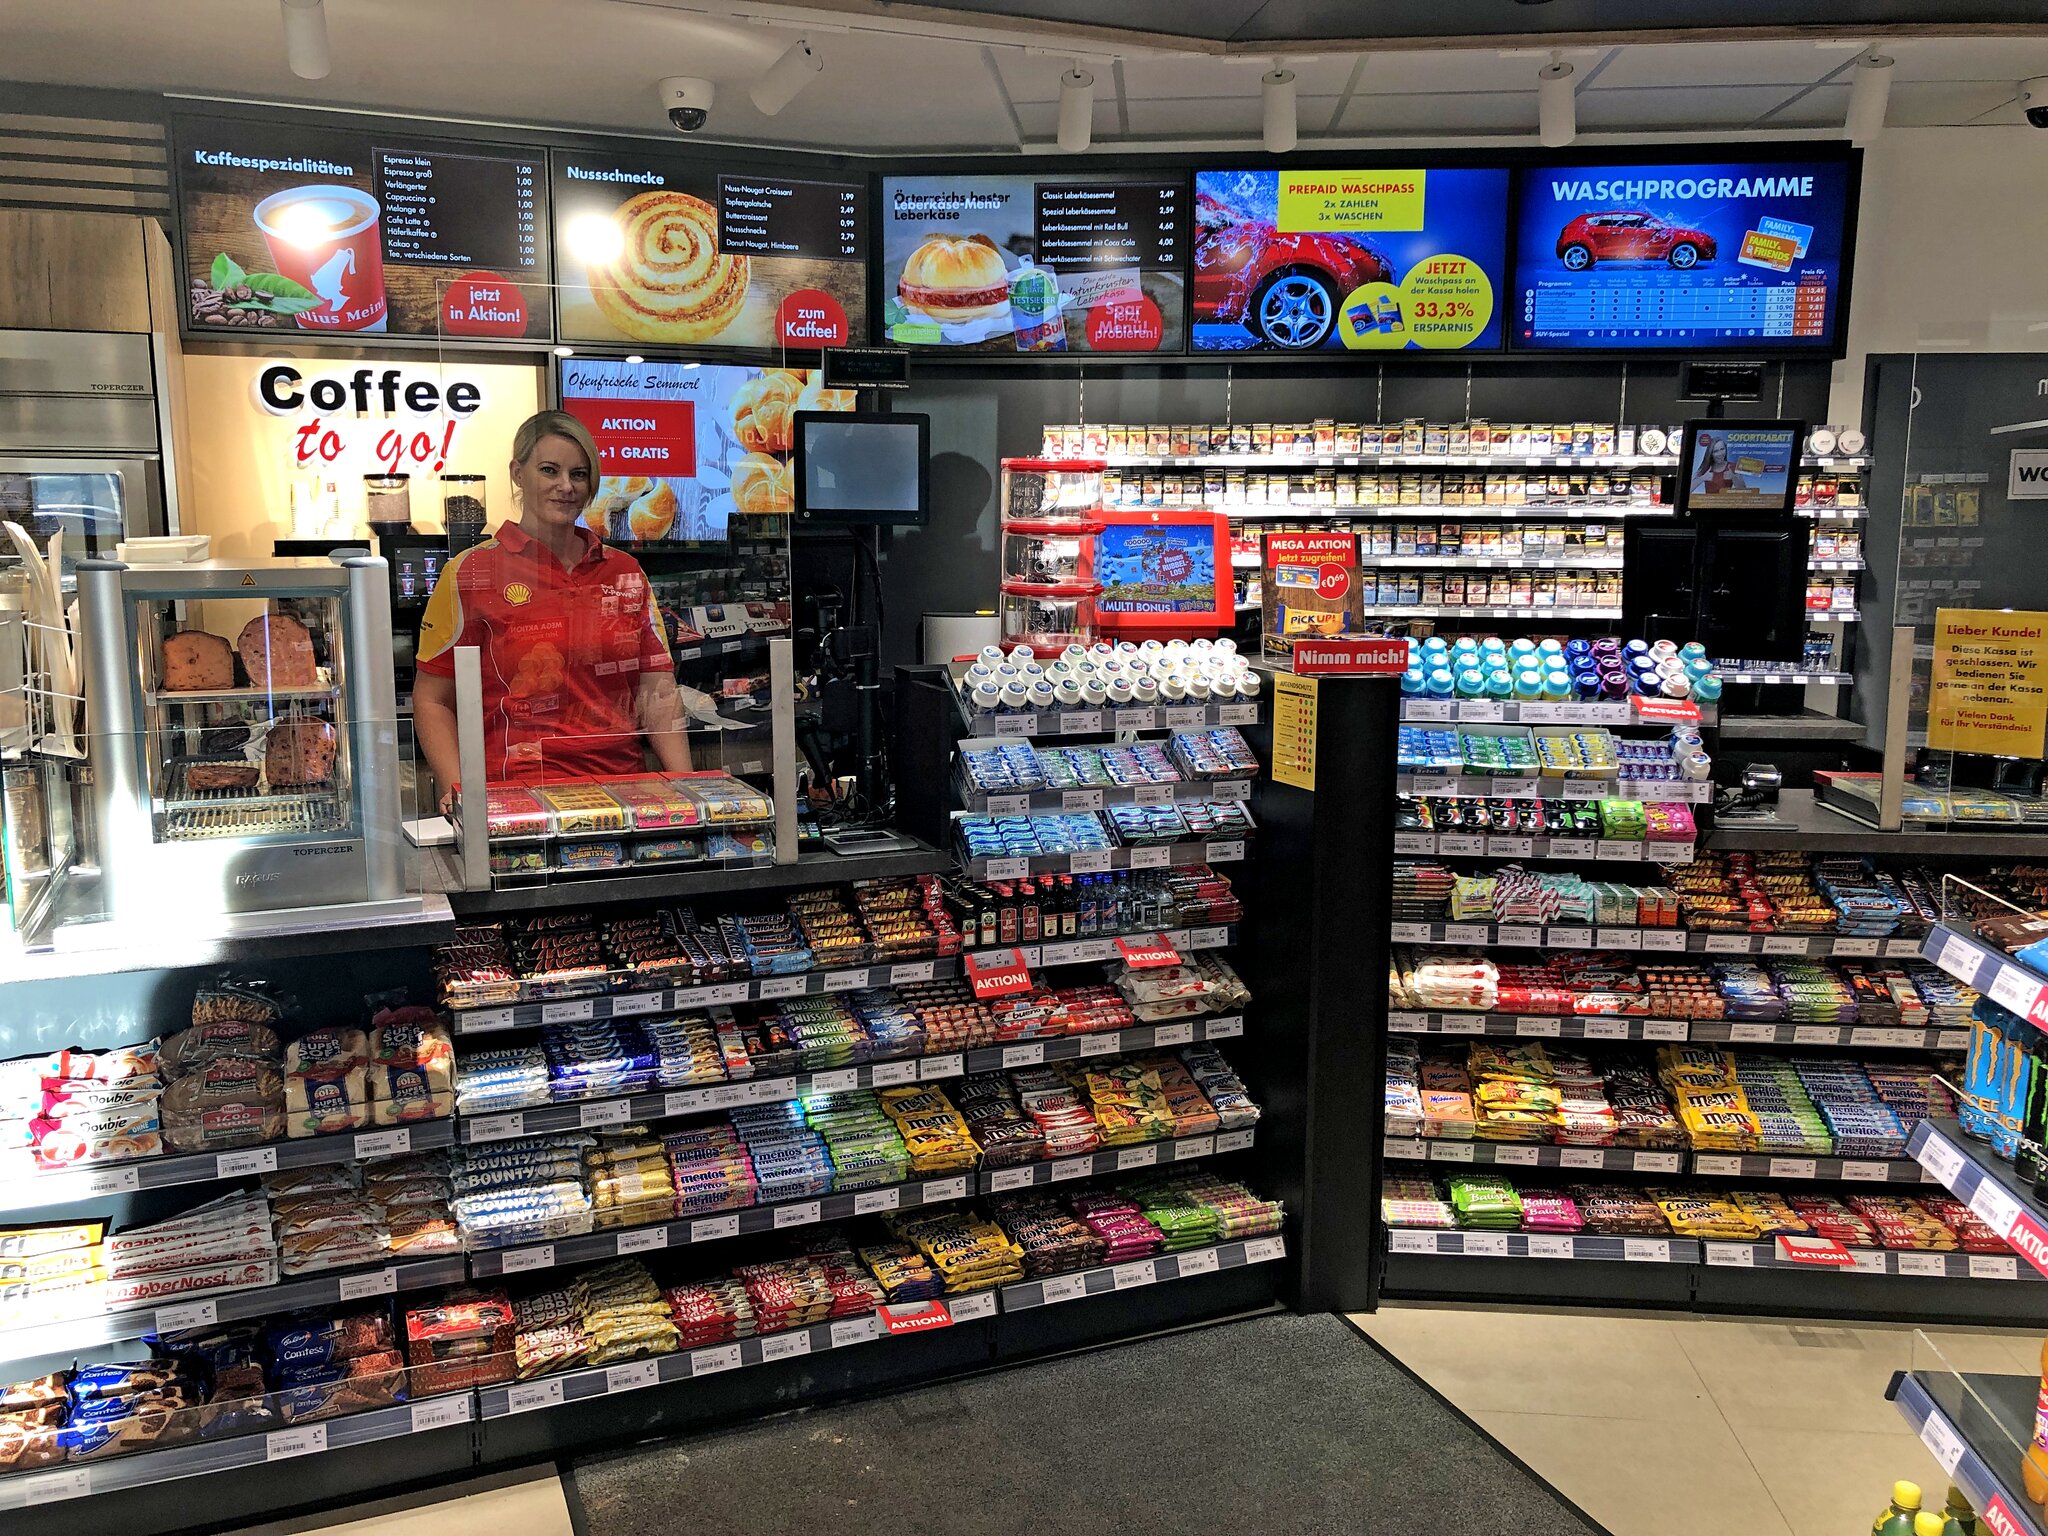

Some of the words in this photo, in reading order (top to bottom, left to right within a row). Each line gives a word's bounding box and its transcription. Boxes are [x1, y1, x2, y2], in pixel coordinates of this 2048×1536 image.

[195, 150, 353, 177] Kaffeespezialitäten
[383, 155, 413, 166] Espresso
[415, 157, 431, 166] klein
[384, 167, 414, 178] Espresso
[416, 170, 432, 180] groß
[516, 166, 531, 175] 1,00
[567, 166, 665, 185] Nussschnecke
[384, 180, 428, 191] Verlängerter
[516, 178, 532, 186] 1,00
[517, 190, 532, 198] 1,00
[724, 184, 764, 196] Nuss-Nougat
[765, 186, 793, 197] Croissant
[1288, 184, 1337, 195] PREPAID
[1342, 184, 1415, 194] WASCHPASS
[1551, 176, 1814, 201] WASCHPROGRAMME
[386, 192, 426, 202] Cappuccino
[840, 192, 854, 201] 1,99
[1042, 191, 1063, 200] Classic
[1064, 191, 1115, 200] Leberkäsesemmel
[1159, 190, 1174, 199] 2,49
[518, 201, 533, 209] 1,00
[725, 198, 772, 209] Topfengolatsche
[1324, 200, 1336, 209] 2x
[1339, 200, 1378, 208] ZAHLEN
[386, 204, 416, 215] Melange
[840, 205, 854, 215] 2,49
[894, 209, 960, 221] Leberkäse
[1042, 207, 1064, 216] Spezial
[1065, 206, 1116, 216] Leberkäsesemmel
[1159, 206, 1174, 215] 2,59
[387, 216, 403, 225] Cafe
[405, 217, 421, 226] Latte
[518, 212, 533, 220] 1,00
[726, 212, 768, 222] Buttercroissant
[1318, 212, 1331, 221] 3x
[1334, 212, 1383, 220] WASCHEN
[518, 224, 533, 232] 1,00
[840, 218, 854, 228] 0,99
[1042, 222, 1092, 232] Leberkäsesemmel
[1093, 223, 1103, 231] mit
[1104, 222, 1116, 231] Red
[1117, 222, 1128, 230] Bull
[1158, 222, 1174, 231] 4,60
[1764, 220, 1793, 233] FAMILY
[388, 228, 429, 238] Häferlkaffee
[726, 225, 766, 236] Nussschnecke
[840, 232, 855, 241] 2,79
[388, 240, 410, 248] Kakao
[726, 239, 744, 248] Donut
[745, 240, 770, 250] Nougat,
[771, 241, 799, 251] Himbeere
[1042, 238, 1092, 247] Leberkäsesemmel
[1093, 238, 1103, 247] mit
[1104, 239, 1119, 247] Coca
[1120, 238, 1136, 247] Cola
[1158, 238, 1173, 247] 4,00
[1749, 236, 1779, 249] FAMILY
[841, 246, 855, 254] 1,89
[1754, 246, 1790, 261] FRIENDS
[389, 251, 402, 259] Tee,
[404, 251, 448, 261] verschiedene
[450, 254, 471, 262] Sorten
[1104, 254, 1141, 263] Schwechater
[1158, 254, 1173, 263] 4,20
[1426, 263, 1466, 274] JETZT
[1415, 277, 1463, 286] Waschpass
[470, 286, 500, 303] jetzt
[1410, 287, 1424, 295] der
[1426, 286, 1453, 294] Kassa
[1456, 286, 1480, 294] holen
[1013, 296, 1056, 305] TESTSIEGER
[346, 296, 384, 322] Meinl
[450, 305, 464, 320] in
[468, 305, 521, 324] Aktion!
[798, 308, 825, 320] zum
[1414, 302, 1474, 318] 33,3%
[786, 323, 837, 339] Kaffee!
[1413, 323, 1474, 333] ERSPARNIS
[568, 372, 639, 391] Ofenfrische
[644, 376, 700, 390] Semmerl
[90, 383, 144, 392] TOPERCZER
[260, 366, 480, 413] Coffee
[602, 418, 656, 431] AKTION
[1727, 433, 1793, 442] SOFORTRABATT
[296, 418, 345, 462] to
[376, 420, 457, 472] go!
[596, 446, 615, 458] +1
[621, 447, 669, 459] GRATIS
[1271, 540, 1304, 550] MEGA
[1308, 540, 1351, 550] AKTION
[1164, 554, 1183, 563] Neues
[1277, 553, 1298, 562] Jetzt
[1301, 553, 1346, 564] zugreifen!
[1162, 560, 1188, 571] RUBBEL-
[1170, 569, 1185, 577] LOS!
[1281, 573, 1294, 582] 5%
[1106, 601, 1133, 612] MULTI
[1136, 602, 1171, 612] BONUS
[1316, 614, 1336, 623] UP!
[1947, 625, 1987, 636] Lieber
[1992, 627, 2041, 638] Kunde!
[1952, 645, 1980, 654] Diese
[1984, 646, 2017, 655] Kassa
[2021, 648, 2034, 656] ist
[1300, 650, 1350, 665] Nimm
[1356, 649, 1404, 664] mich!
[1946, 658, 2013, 668] geschlossen.
[2018, 660, 2037, 669] Wir
[1956, 669, 2005, 679] bedienen
[2009, 672, 2025, 680] Sie
[1280, 681, 1312, 692] JUGENDSCHUTZ
[1988, 682, 2006, 691] der
[2010, 684, 2044, 694] Kassa
[1963, 694, 2013, 704] nebenan.
[1640, 705, 1697, 716] AKTION!
[1958, 710, 1986, 719] Vielen
[1990, 712, 2015, 721] Dank
[1973, 721, 2032, 732] Verständnis!
[293, 845, 354, 856] TOPERCZER
[657, 843, 677, 851] CASH
[1128, 950, 1176, 961] AKTION!
[449, 965, 514, 985] TWIX
[976, 972, 1027, 990] AKTION!
[1012, 1007, 1041, 1018] bueno
[844, 1157, 886, 1170] mentos
[468, 1166, 535, 1187] BOUNTY
[680, 1170, 726, 1184] mentos
[1470, 1193, 1510, 1202] Balisto
[933, 1238, 978, 1254] CORNY
[1791, 1250, 1849, 1261] AKTION!
[891, 1314, 947, 1330] AKTION!
[284, 1345, 324, 1360] Comtess
